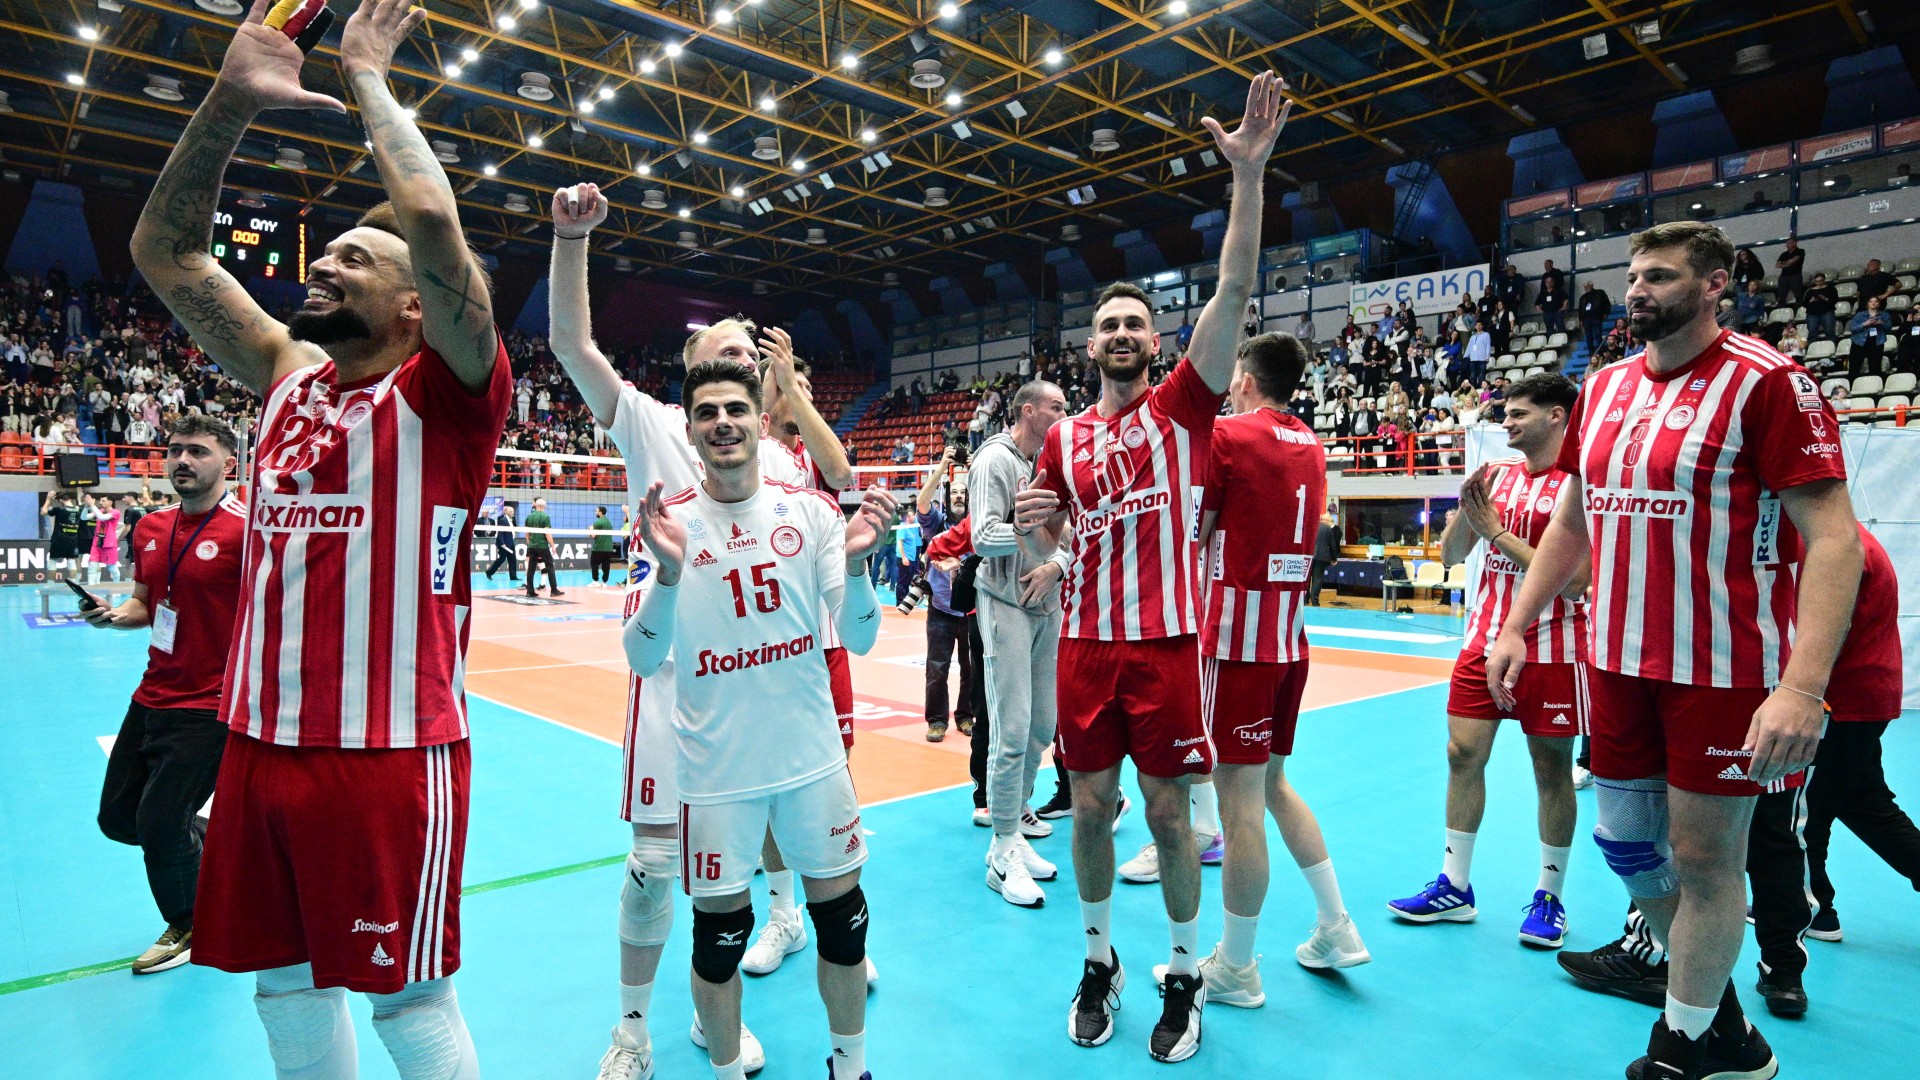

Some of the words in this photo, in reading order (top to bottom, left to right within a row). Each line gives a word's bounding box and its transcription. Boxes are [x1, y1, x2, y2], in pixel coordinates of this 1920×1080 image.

[232, 229, 260, 245] 0:00
[269, 252, 279, 265] 0
[1621, 422, 1651, 468] 8
[1091, 450, 1136, 497] 10
[1293, 484, 1306, 543] 1
[433, 525, 454, 591] RaC
[692, 557, 718, 568] adidas
[722, 562, 782, 619] 15
[695, 633, 814, 678] Stoiximan
[1705, 746, 1755, 757] Stoixima
[640, 777, 656, 805] 6
[1717, 773, 1748, 781] adidas
[694, 851, 722, 881] 15
